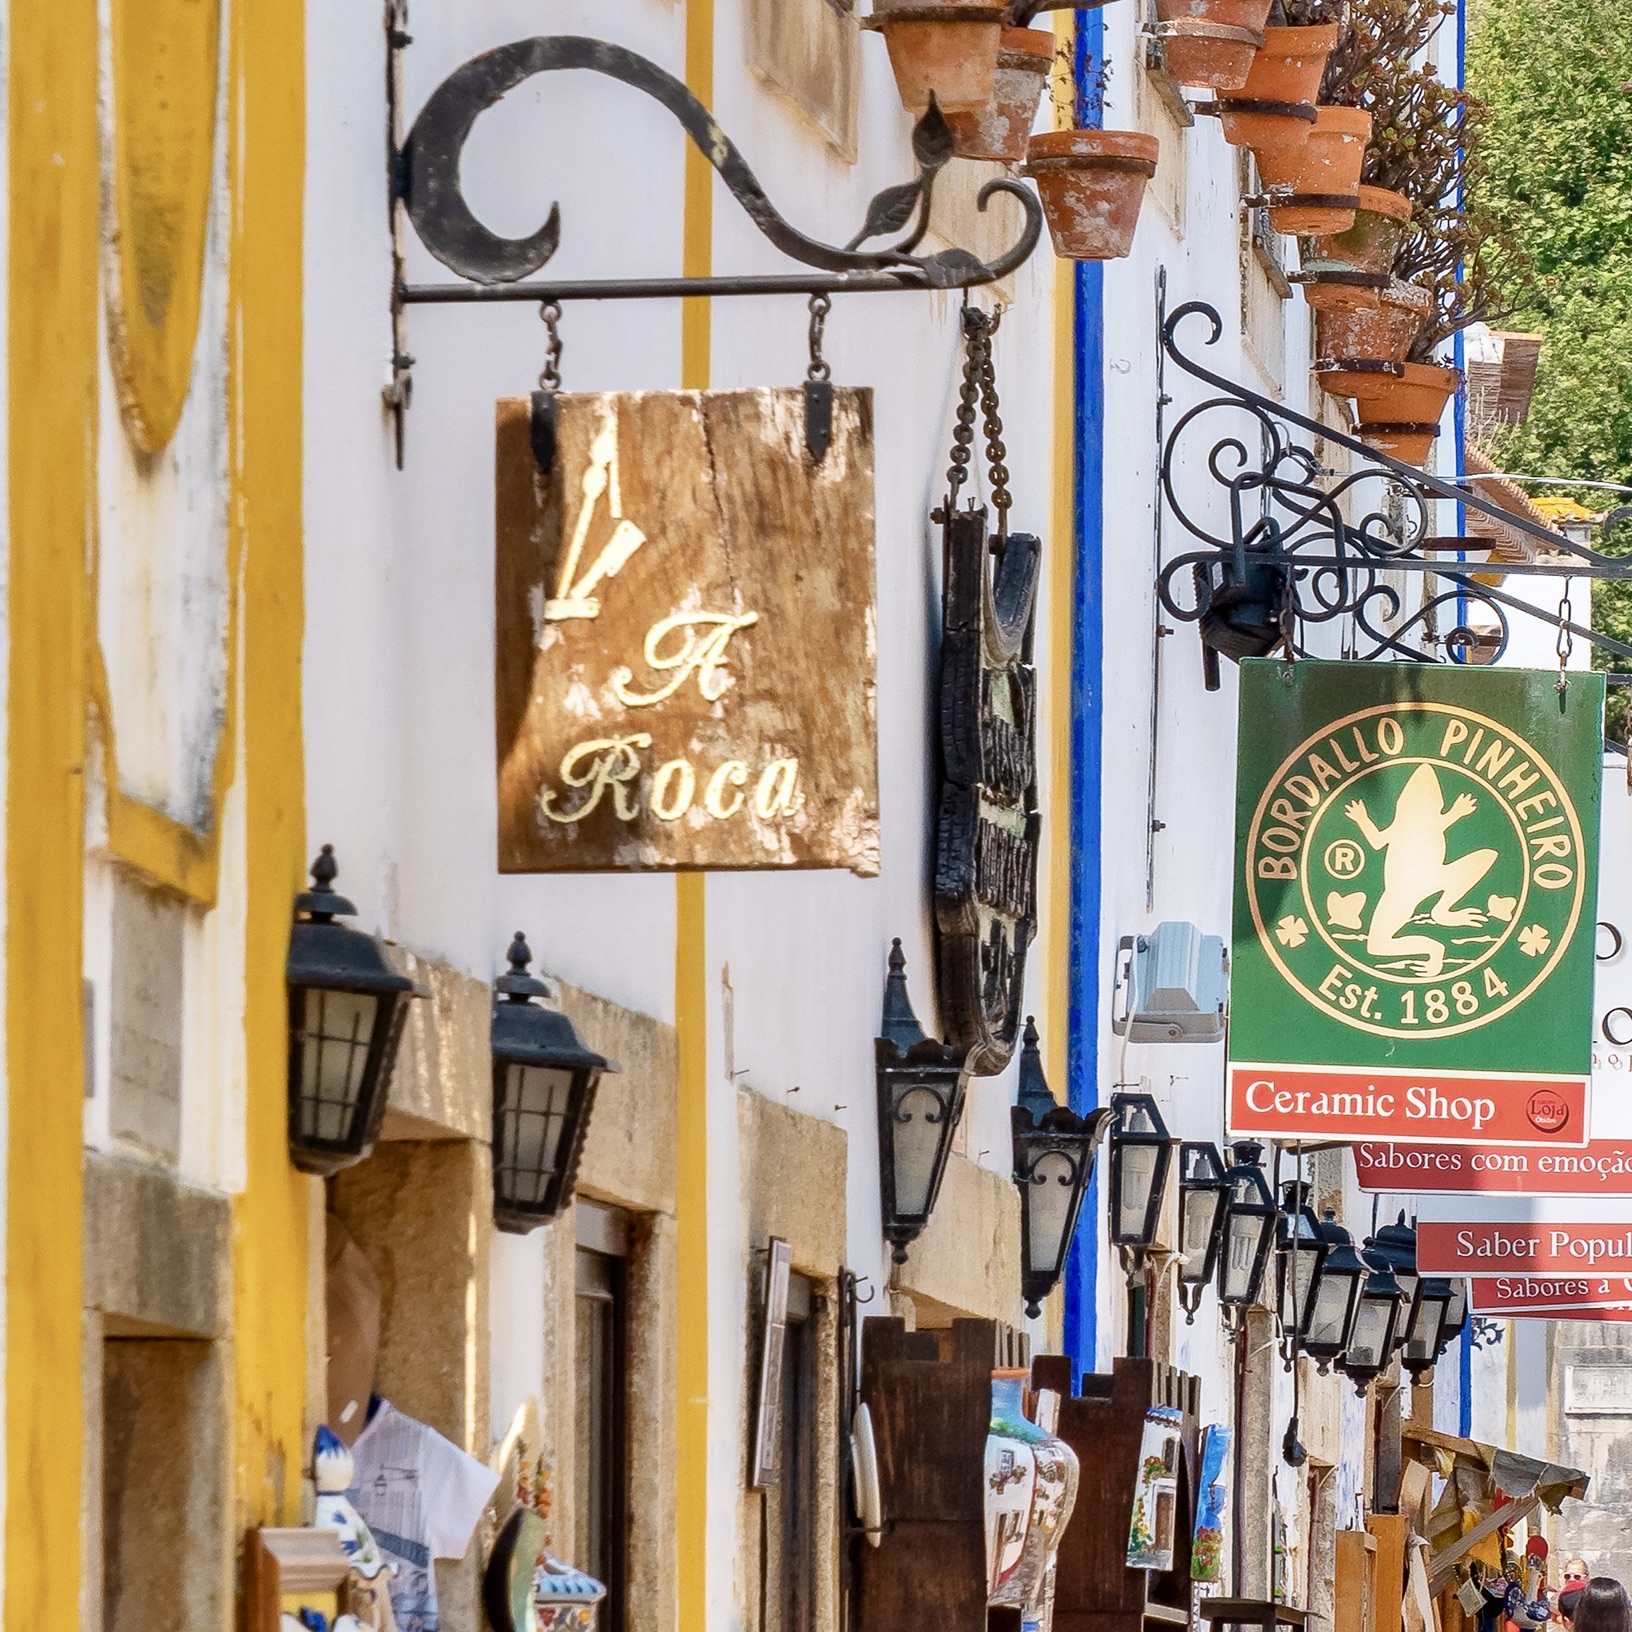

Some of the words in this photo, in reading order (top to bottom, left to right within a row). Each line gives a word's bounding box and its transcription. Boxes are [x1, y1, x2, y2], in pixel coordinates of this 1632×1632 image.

[613, 611, 758, 706] A
[540, 733, 805, 823] Roca
[1259, 718, 1404, 880] BORDALLO
[1440, 719, 1573, 890] PINHEIRO
[1318, 964, 1383, 1020] Est.
[1400, 967, 1509, 1024] 1884
[1246, 1080, 1395, 1117] Ceramic
[1405, 1086, 1496, 1130] Shop
[1530, 1099, 1565, 1119] Loja
[1359, 1143, 1462, 1170] Sabores
[1471, 1153, 1528, 1172] com
[1456, 1230, 1540, 1257] Saber
[1496, 1277, 1589, 1299] Sabores
